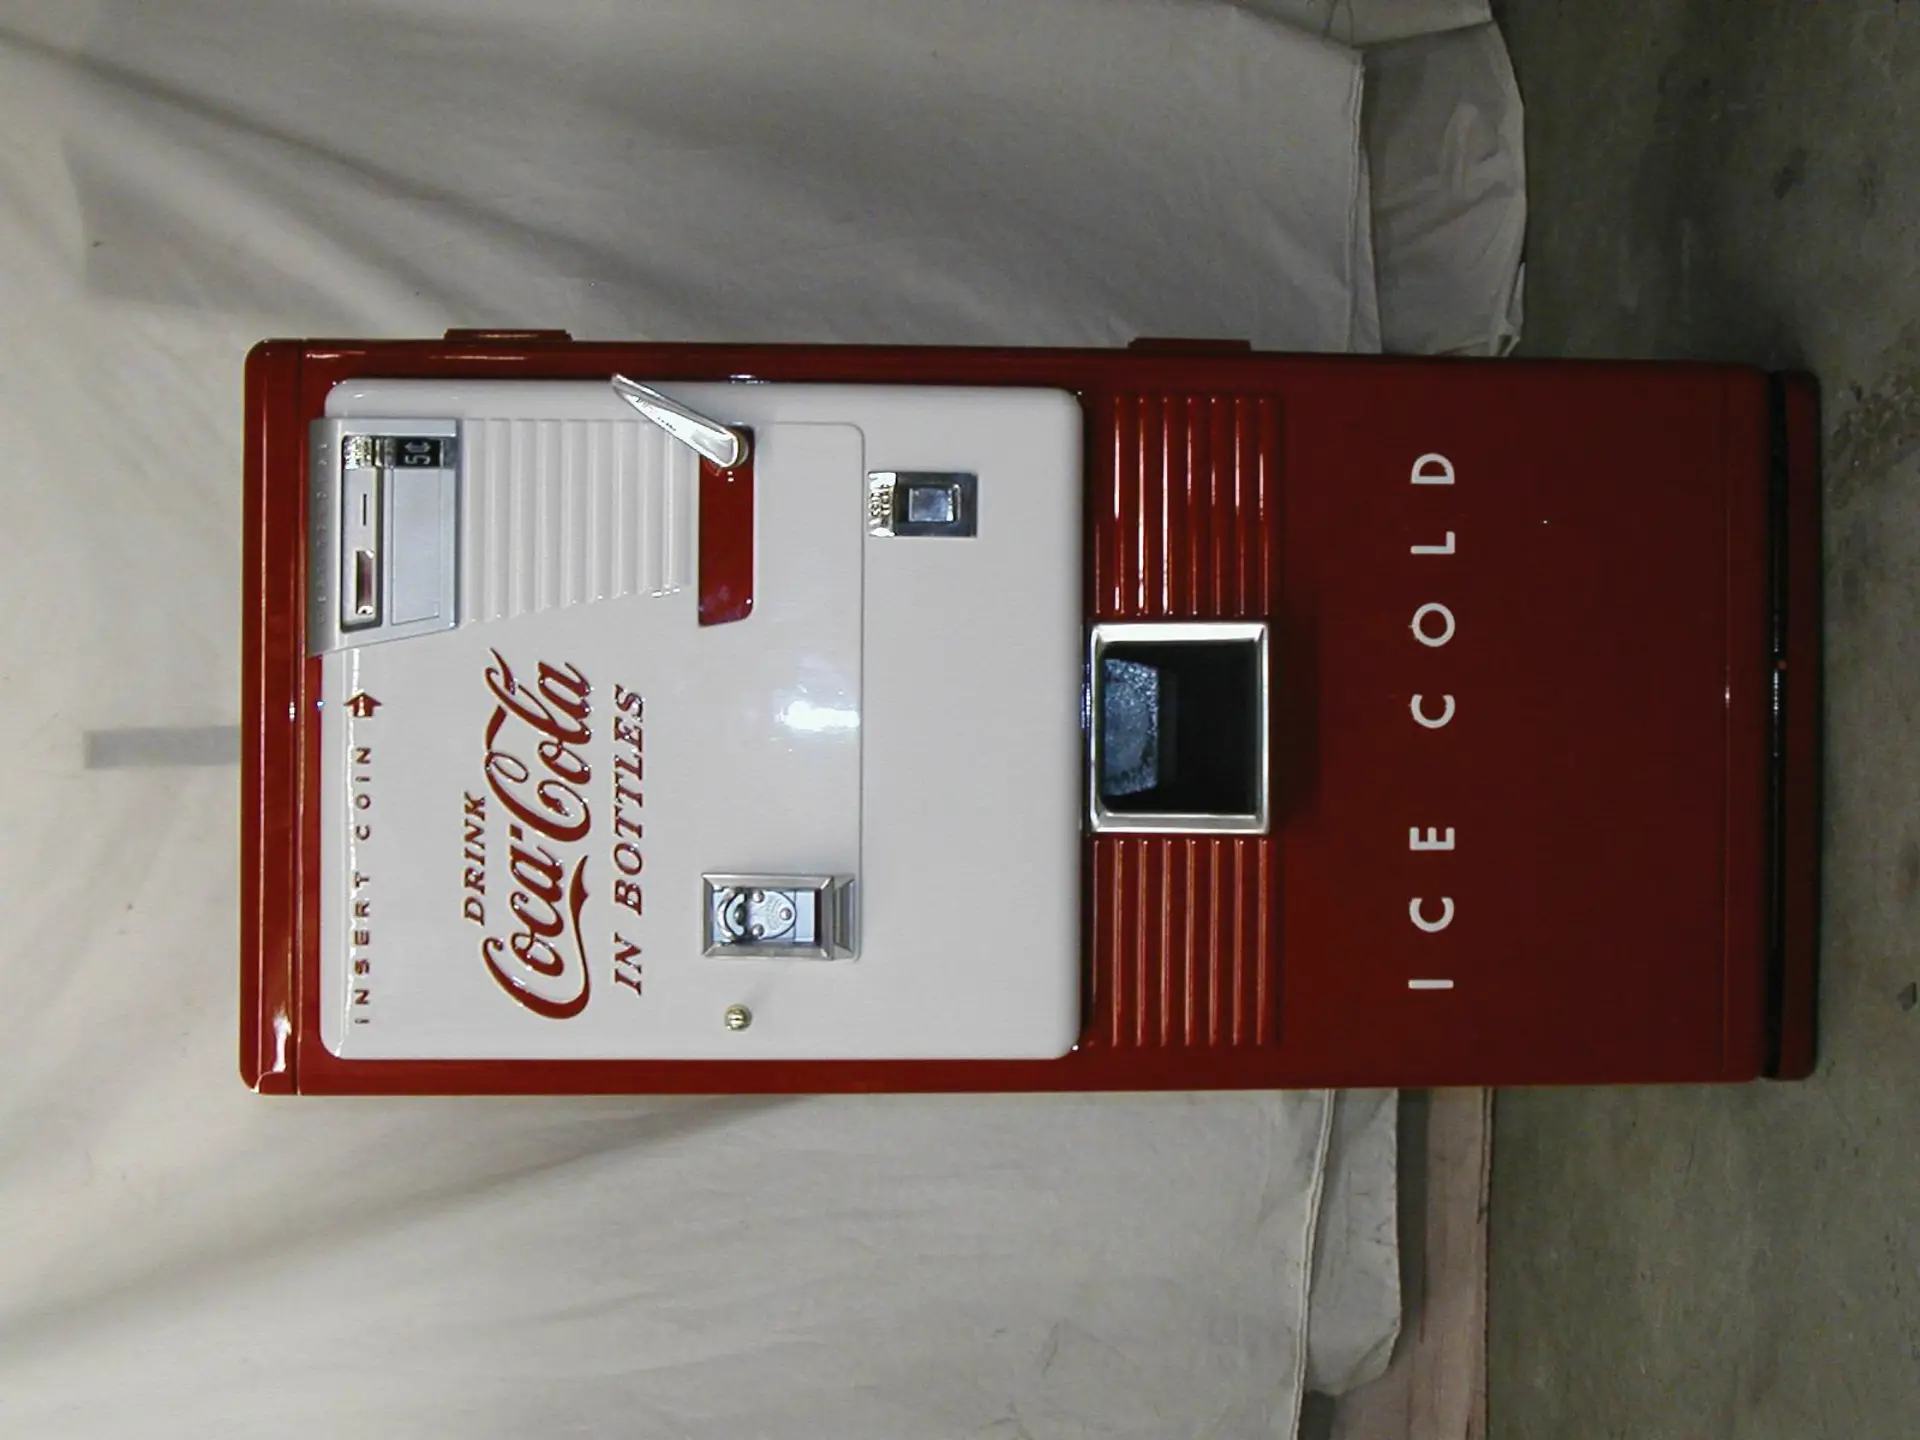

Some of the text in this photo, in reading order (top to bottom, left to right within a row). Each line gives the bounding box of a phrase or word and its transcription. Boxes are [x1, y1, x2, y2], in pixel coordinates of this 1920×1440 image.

[404, 441, 431, 465] 5¢
[463, 791, 486, 927] DRINK
[481, 647, 592, 1020] Coca-Cola
[613, 683, 644, 996] IN BOTTLES
[1408, 452, 1456, 990] ICE COLD
[354, 745, 371, 1025] INSERT COIN
